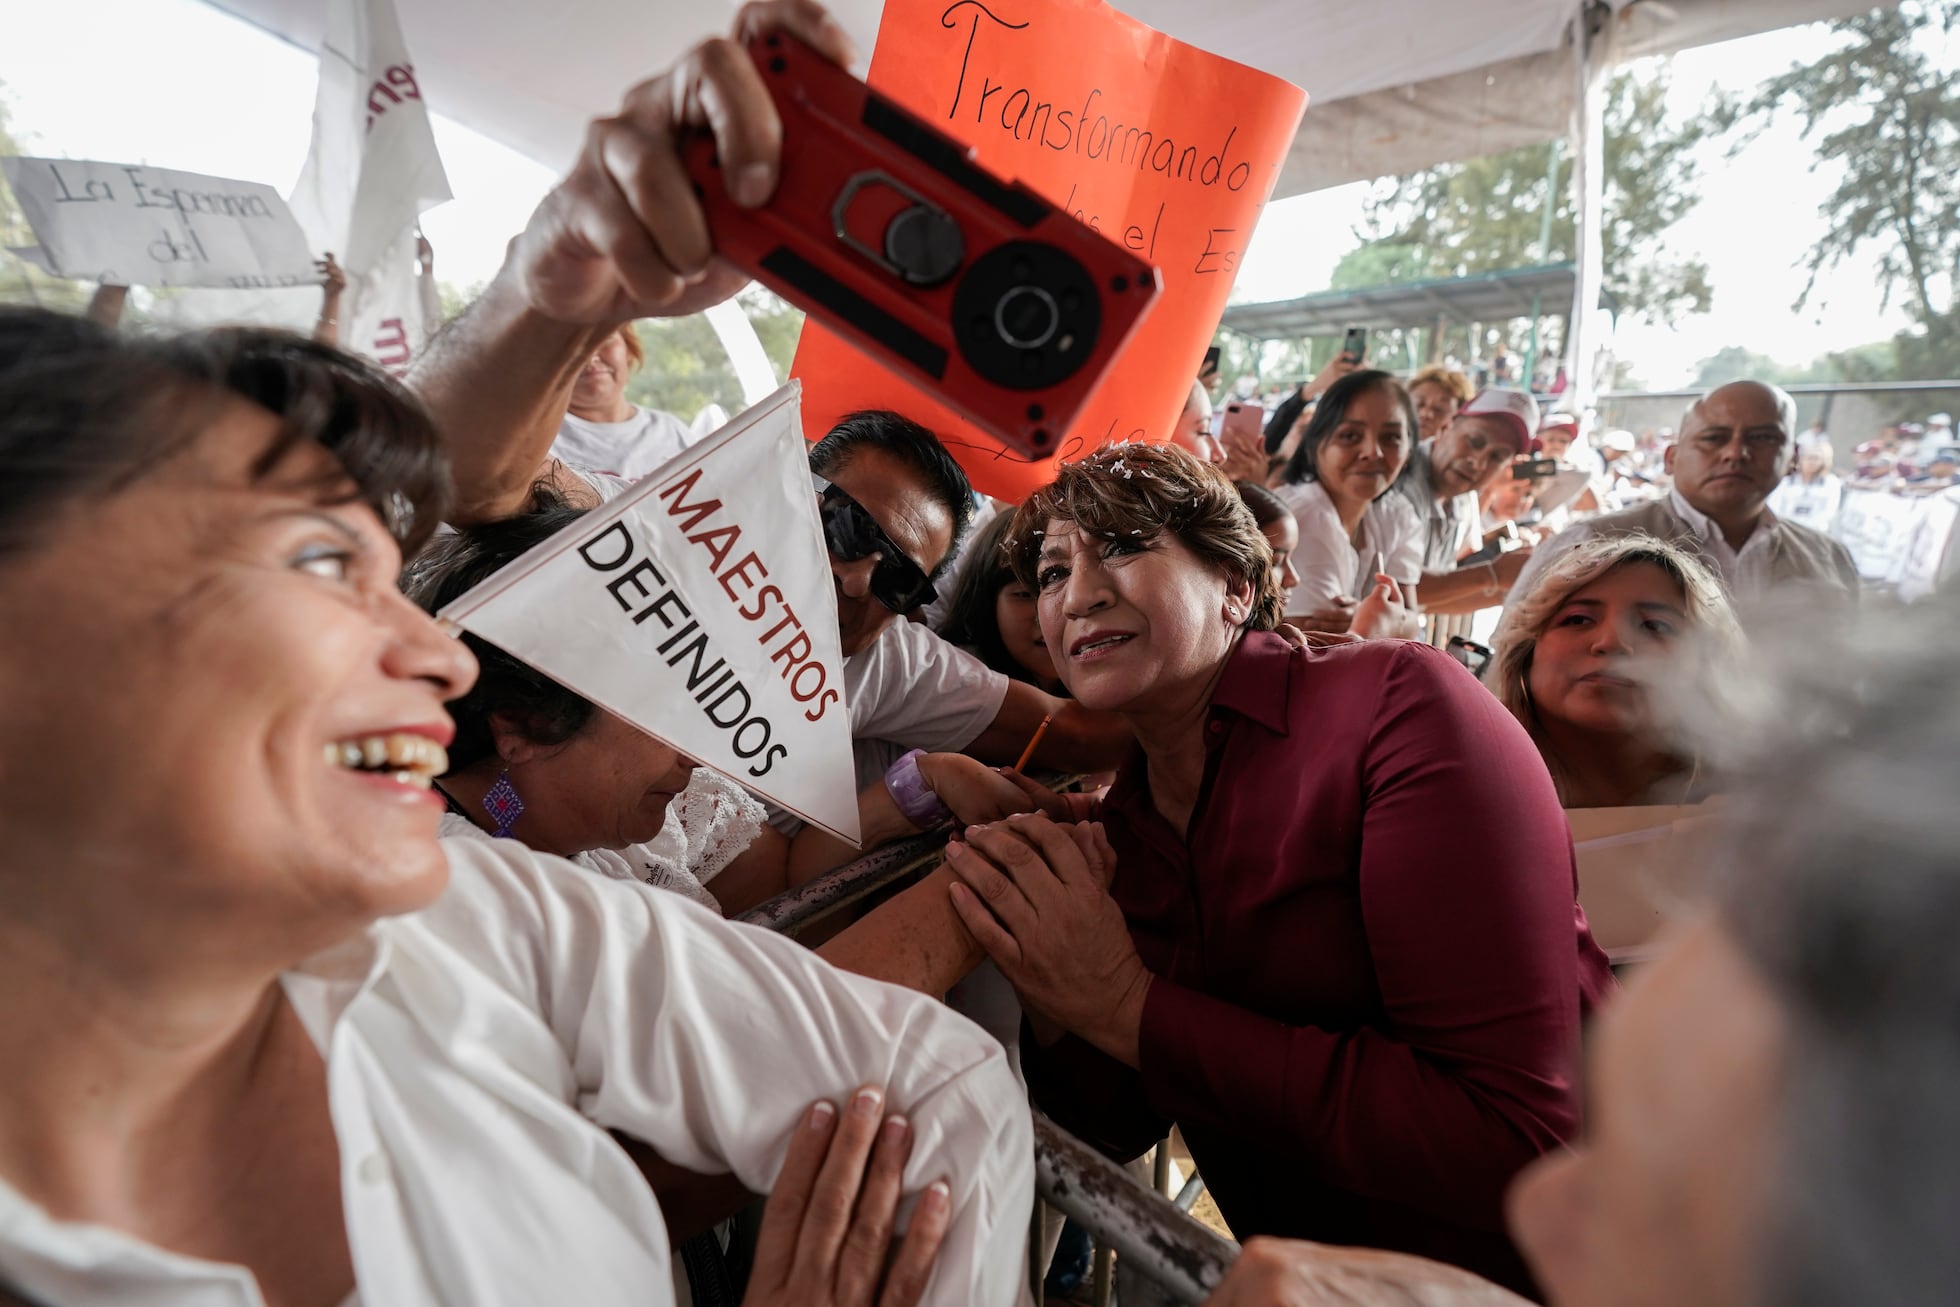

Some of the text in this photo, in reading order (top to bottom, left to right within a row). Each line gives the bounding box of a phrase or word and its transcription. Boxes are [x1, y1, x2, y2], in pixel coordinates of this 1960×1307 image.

[941, 0, 1250, 192] Transformando
[49, 163, 115, 203] La
[147, 228, 209, 264] del
[1123, 202, 1165, 260] el
[1194, 228, 1242, 274] Es
[577, 520, 788, 777] DEFINIDOS
[659, 467, 839, 722] MAESTROS
